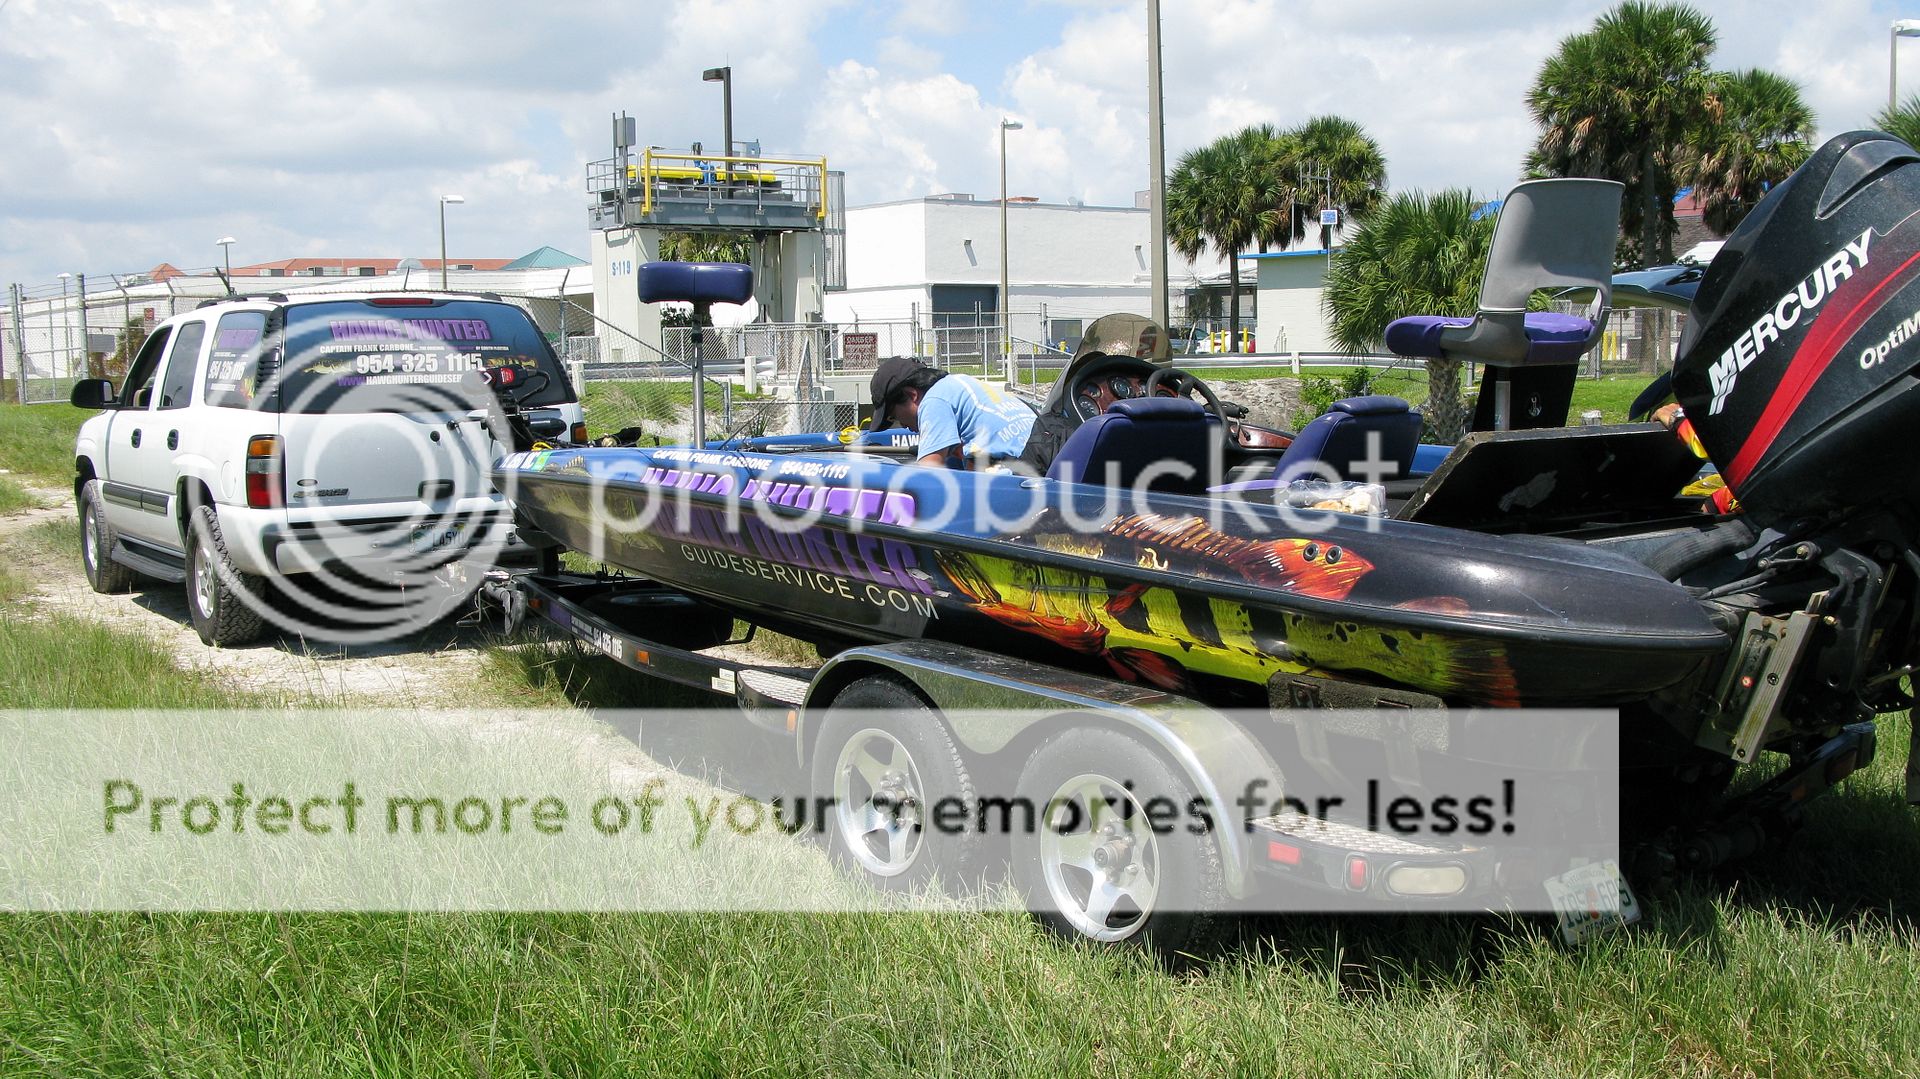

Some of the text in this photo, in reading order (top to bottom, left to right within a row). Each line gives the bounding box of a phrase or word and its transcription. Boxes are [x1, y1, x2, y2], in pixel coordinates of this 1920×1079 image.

[611, 260, 631, 276] S-119
[330, 319, 493, 342] HAWG HUNTER
[1708, 226, 1873, 416] MERCURY
[319, 345, 352, 354] CAPTAIN
[353, 344, 378, 353] FRANK
[356, 352, 483, 374] 954 325 1115
[652, 450, 691, 462] CAPTAIN
[690, 452, 721, 465] FRANK
[680, 544, 940, 620] GUIDESERVICE.COM
